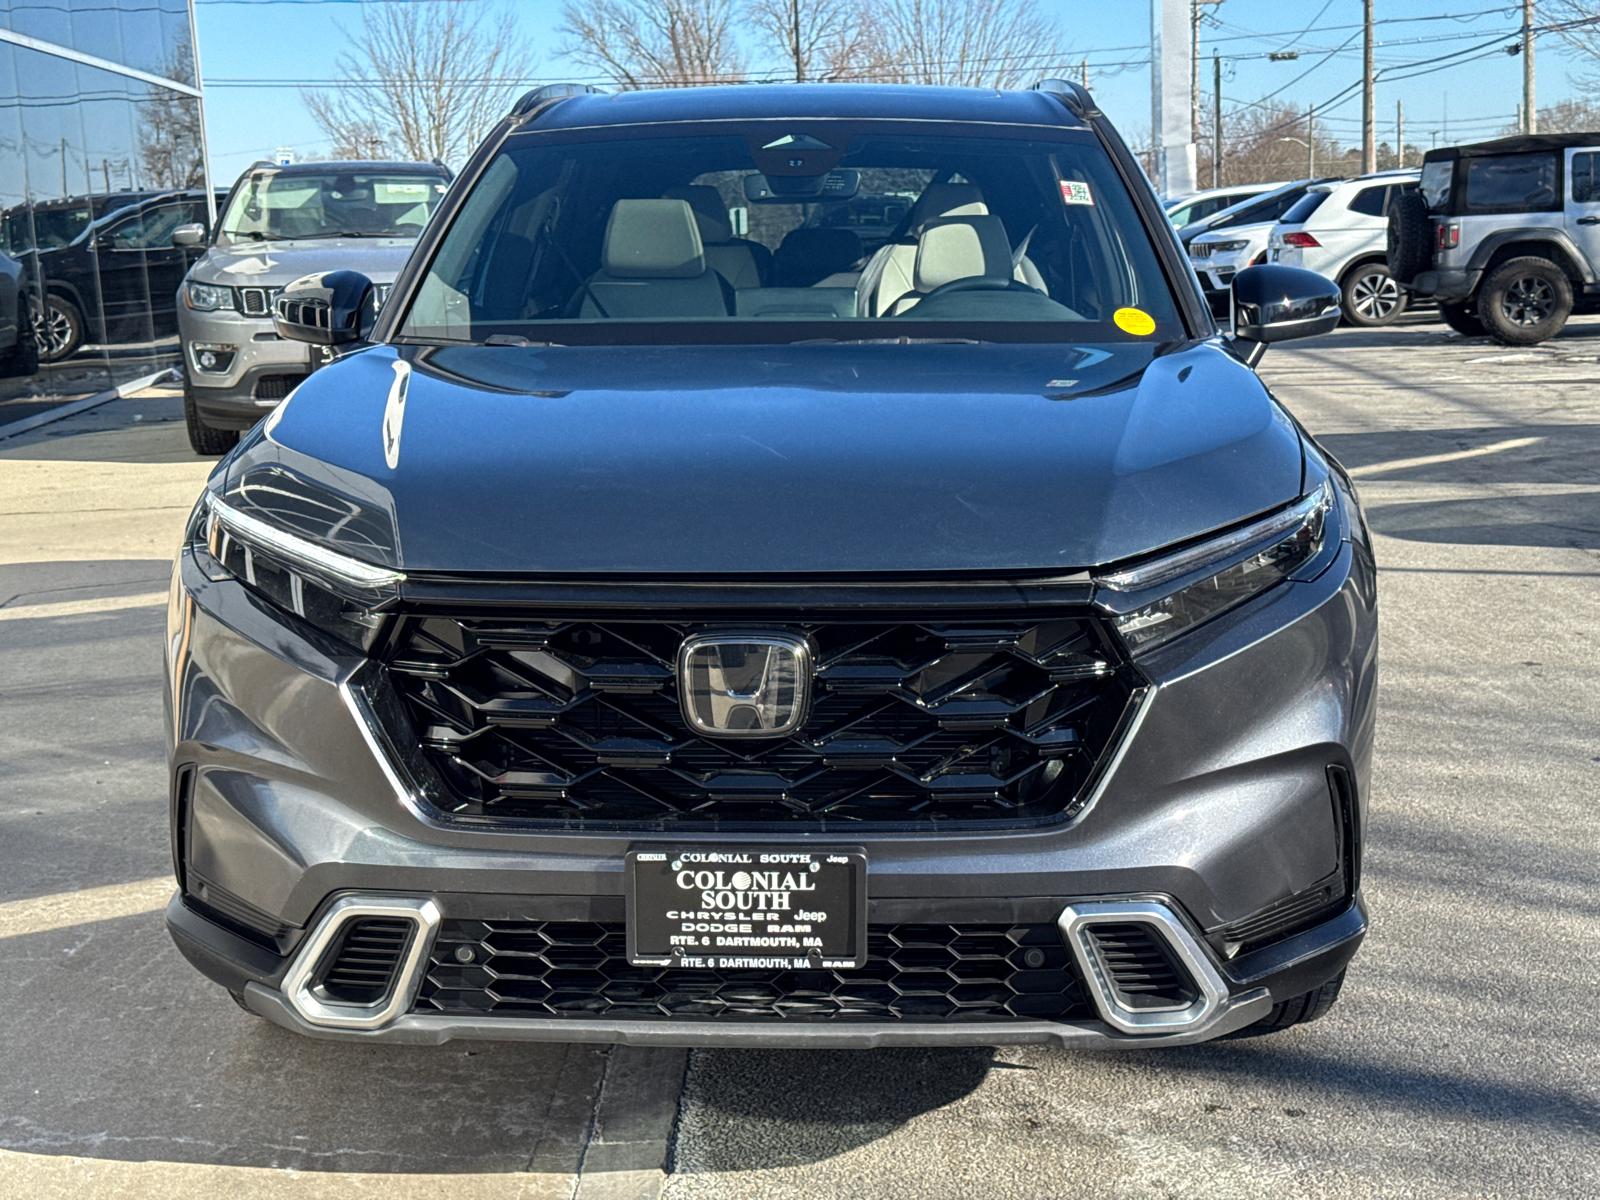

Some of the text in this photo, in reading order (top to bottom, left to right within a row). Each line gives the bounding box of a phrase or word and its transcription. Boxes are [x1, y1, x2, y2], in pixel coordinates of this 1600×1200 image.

[680, 852, 812, 864] COLONIAL SOUTH
[826, 855, 849, 864] Jeep
[676, 870, 816, 892] COLONIAL
[701, 890, 791, 910] SOUTH
[666, 909, 827, 922] CHRYSLER Jeep
[681, 922, 812, 933] DODGE RAM
[670, 935, 823, 948] RTE. 6 DARTMOUTH, MA
[680, 958, 811, 969] RTE. 6 DARTMOUTH, MA
